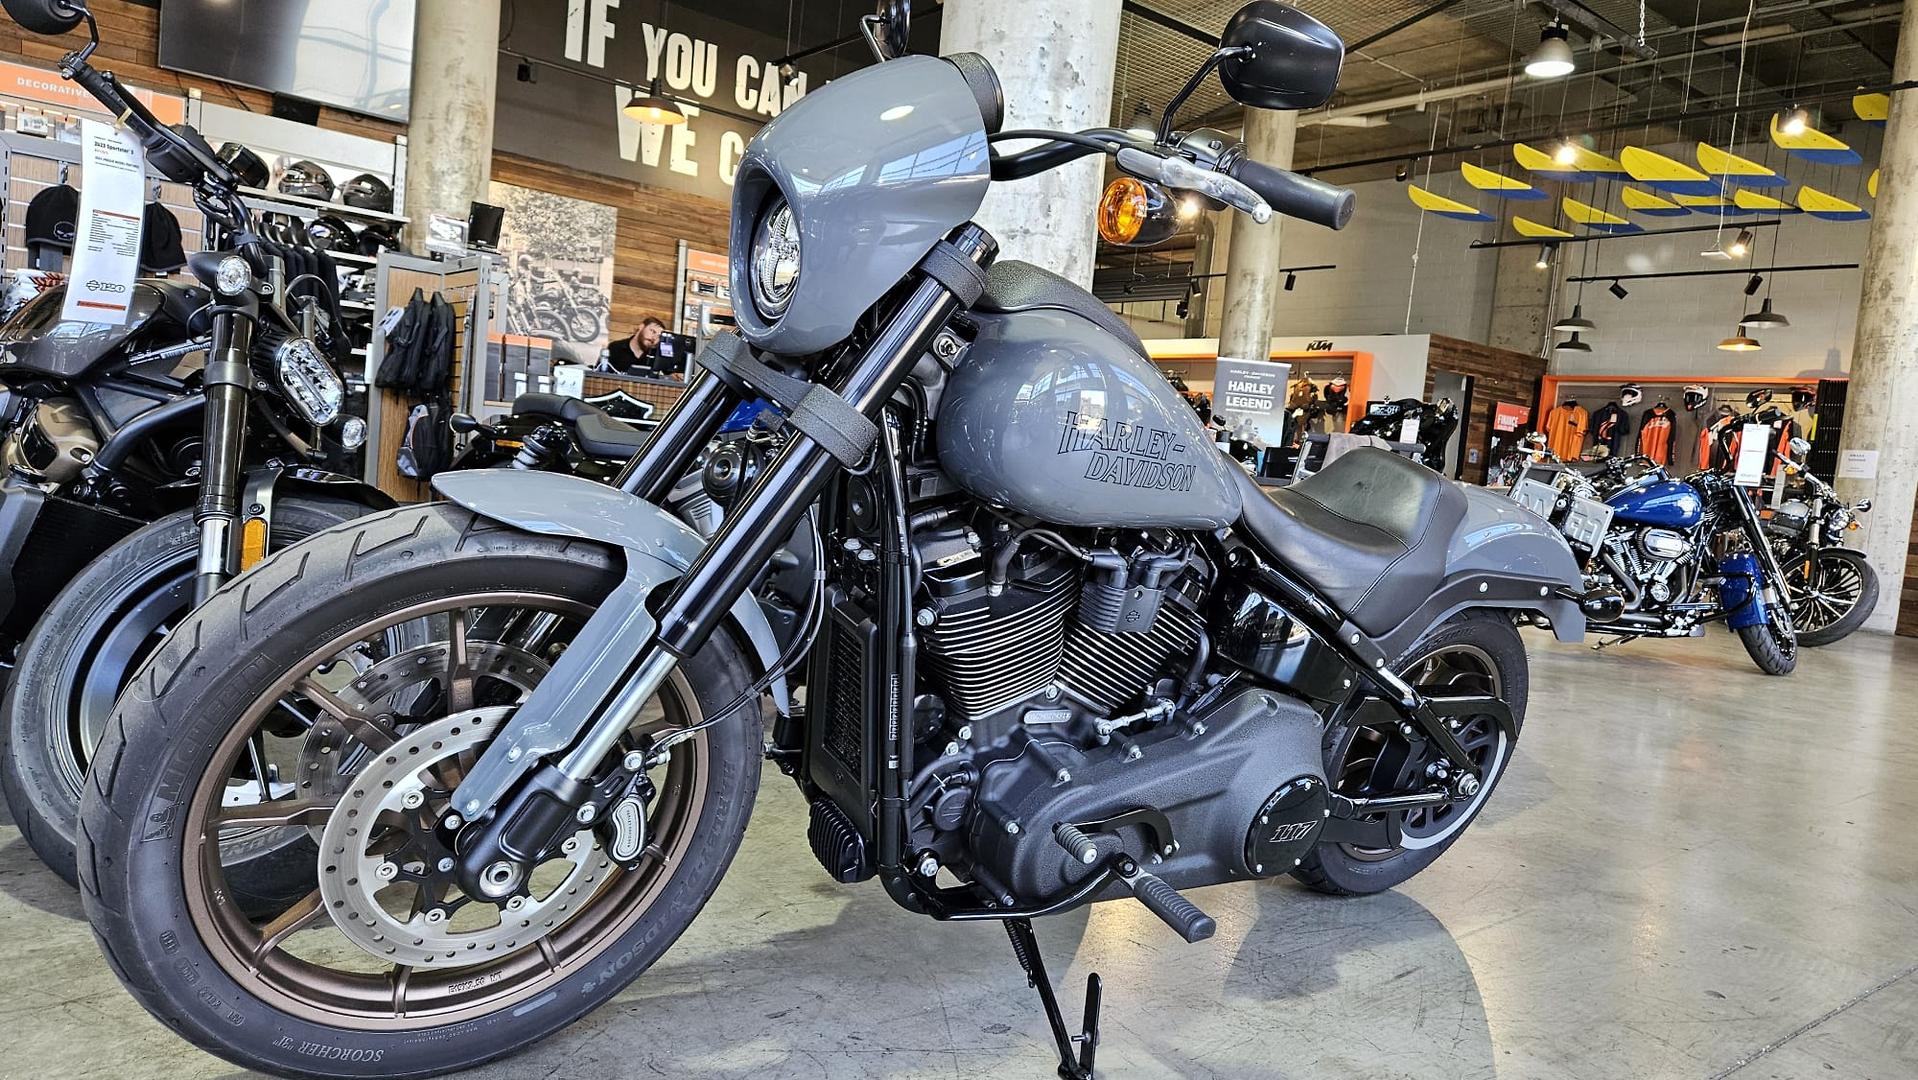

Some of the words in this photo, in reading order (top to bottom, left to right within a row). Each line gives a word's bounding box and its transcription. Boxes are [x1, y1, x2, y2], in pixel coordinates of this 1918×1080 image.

[565, 0, 621, 69] IF
[641, 22, 719, 98] YOU
[17, 76, 91, 98] DECORATIVE
[614, 79, 700, 177] WE
[1306, 340, 1333, 352] KTM
[1228, 380, 1275, 395] HARLEY
[1226, 396, 1273, 410] LEGEND
[1057, 410, 1186, 461] HARLEY-
[1084, 451, 1197, 491] DAVIDSON
[1269, 820, 1319, 843] 117
[298, 1040, 385, 1062] SCORCHER
